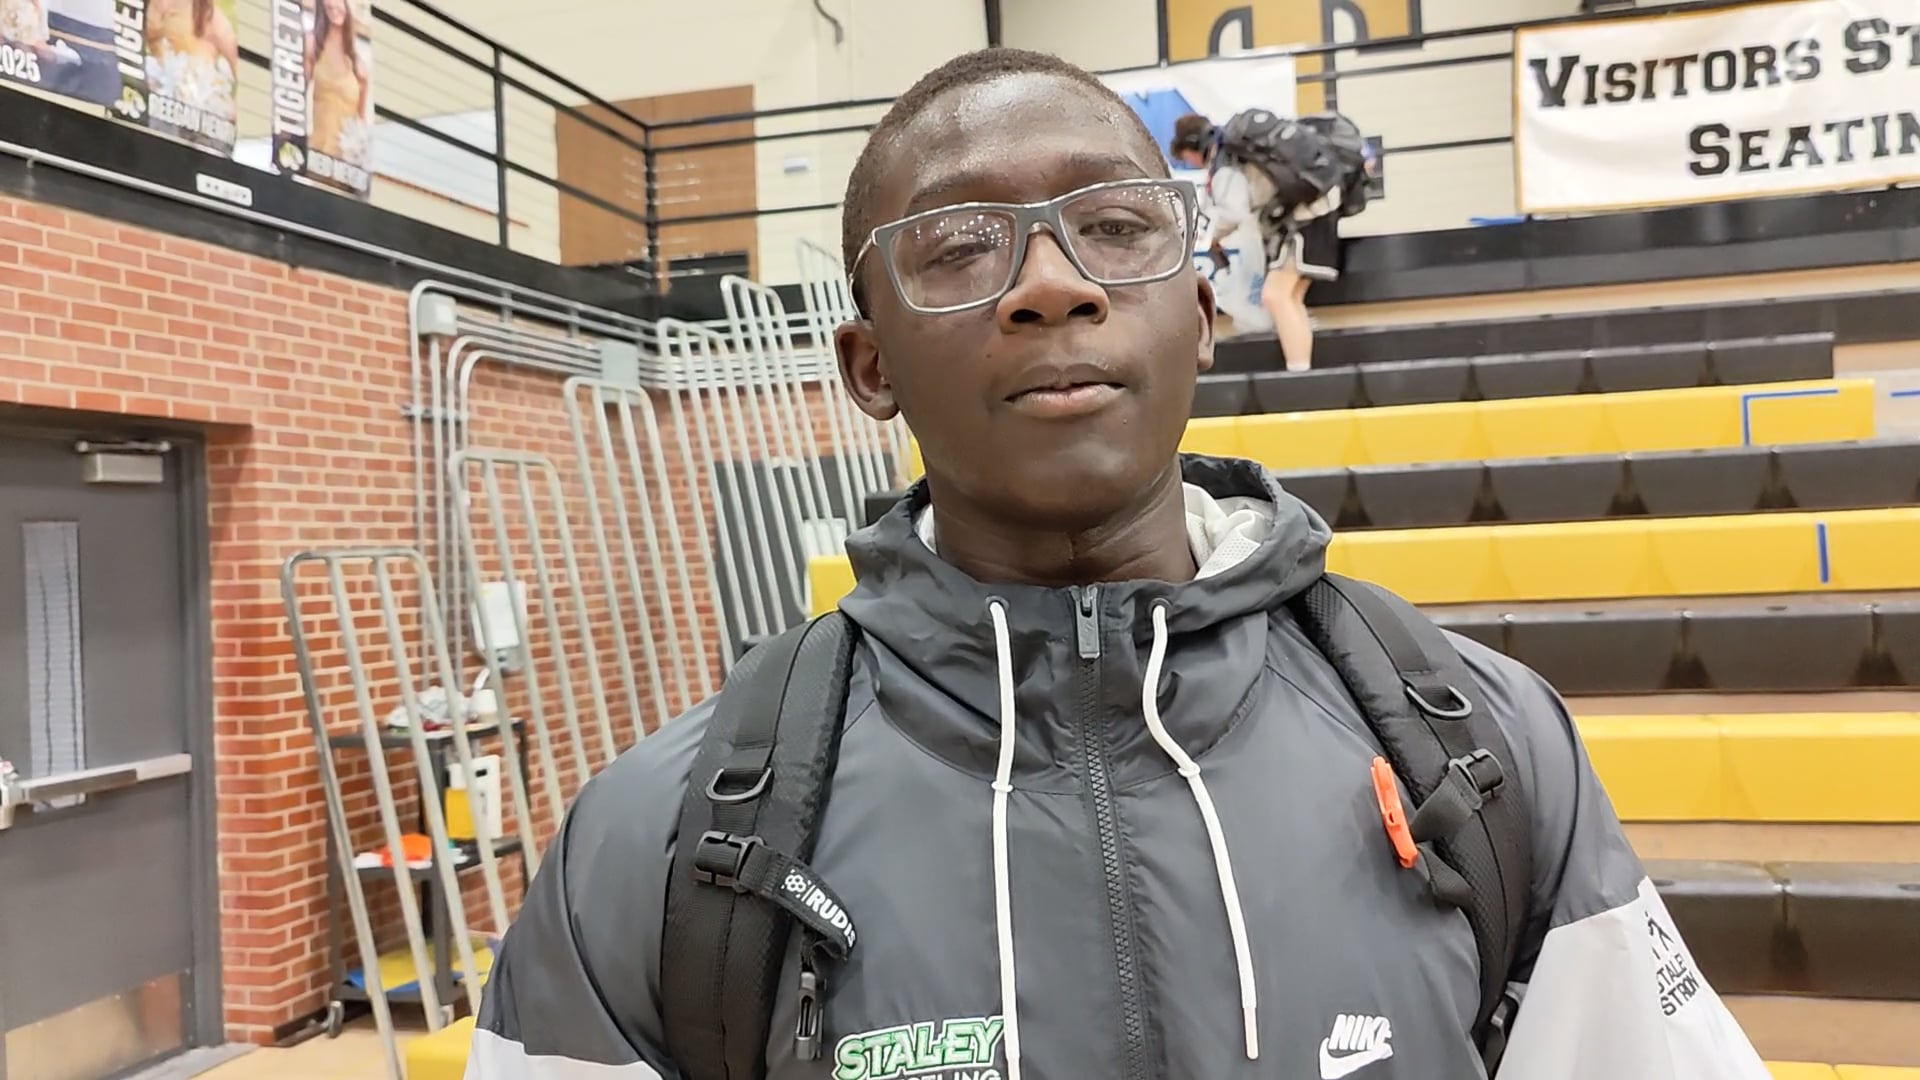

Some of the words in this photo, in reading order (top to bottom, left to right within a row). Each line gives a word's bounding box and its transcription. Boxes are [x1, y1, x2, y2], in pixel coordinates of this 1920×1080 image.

[1529, 38, 1820, 107] VISITORS
[832, 1016, 1004, 1080] STALEY
[1328, 1013, 1392, 1051] NIKE
